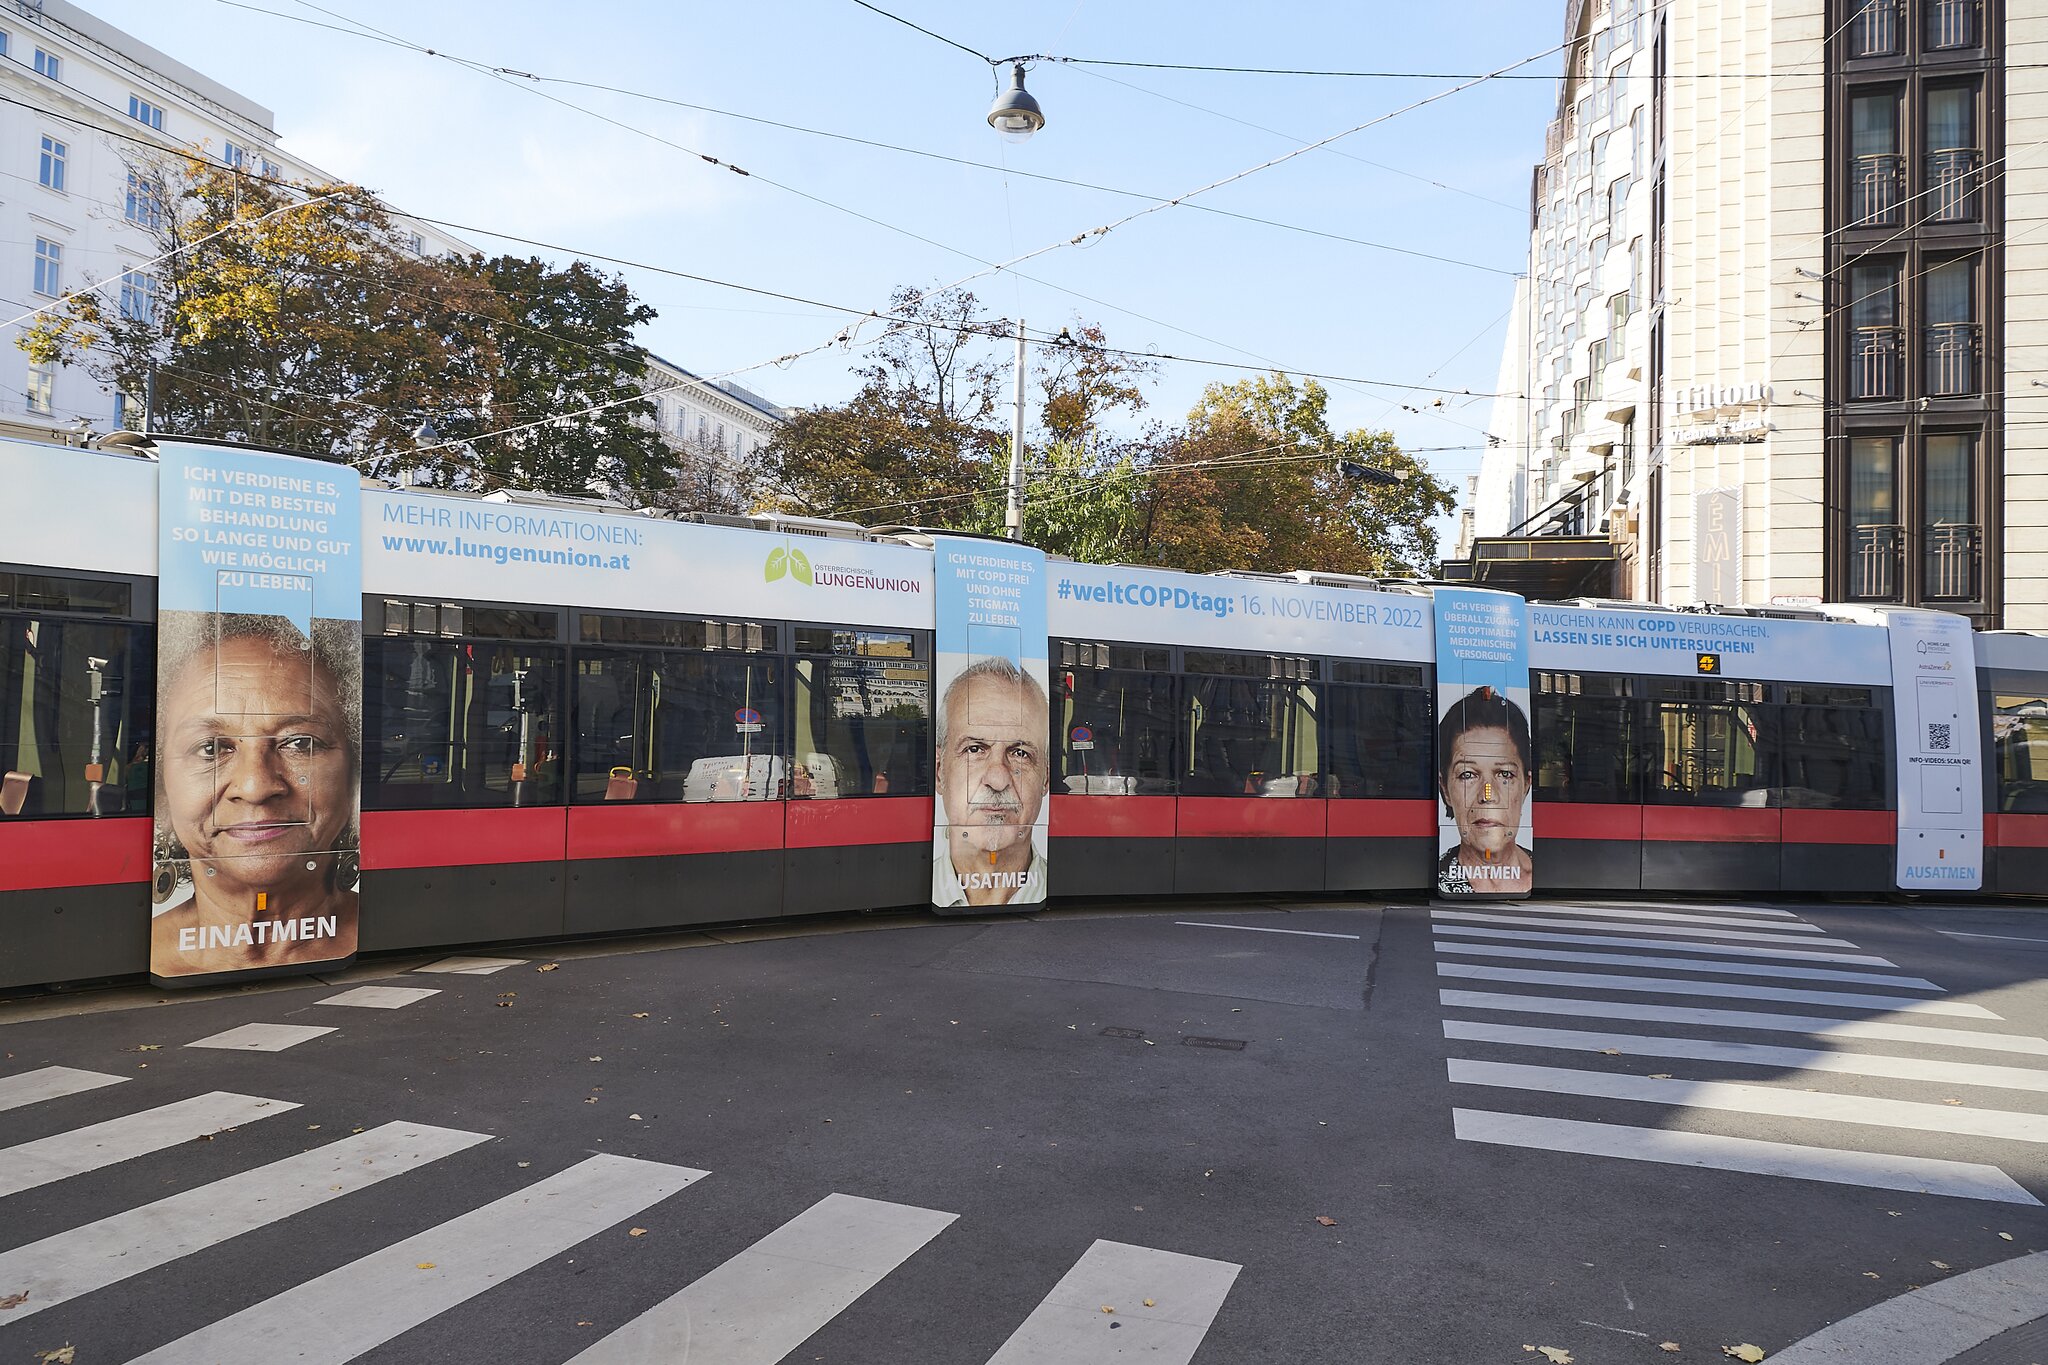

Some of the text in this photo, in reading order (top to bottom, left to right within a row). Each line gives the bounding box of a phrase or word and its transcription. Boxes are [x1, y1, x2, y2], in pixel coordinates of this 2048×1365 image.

[184, 466, 341, 499] ICH VERDIENE ES,
[189, 487, 337, 516] MIT DER BESTEN
[200, 508, 328, 534] BEHANDLUNG
[383, 502, 643, 547] MEHR INFORMATIONEN:
[172, 527, 351, 556] SO LANGE UND GUT
[202, 550, 327, 573] WIE MÖGLICH
[382, 535, 630, 571] www.lungenunion.at
[948, 553, 1036, 573] ICH VERDIENE ES,
[814, 564, 874, 576] ÖSTERREICHISCHE
[956, 568, 1030, 585] MIT COPD FREI
[218, 572, 312, 592] ZU LEBEN.
[815, 572, 920, 594] LUNGENUNION
[966, 584, 1021, 598] UND OHNE
[968, 598, 1020, 612] STIGMATA
[1058, 578, 1423, 628] #weltCOPDtag: 16. NOVEMBER 2022
[1452, 602, 1511, 615] ICH VERDIENE
[968, 612, 1020, 626] ZU LEBEN.
[1444, 611, 1520, 627] ÜBERALL ZUGANG
[1533, 612, 1770, 639] RAUCHEN KANN COPD VERURSACHEN.
[1448, 625, 1516, 638] ZUR OPTIMALEN
[1450, 637, 1516, 650] MEDIZINISCHEN
[1534, 630, 1755, 654] LASSEN SIE SICH UNTERSUCHEN!
[1453, 649, 1514, 662] VERSORGUNG.
[946, 872, 1038, 890] USATMEN
[1448, 865, 1520, 880] EINATMEN
[1905, 866, 1976, 880] AUSATMEN
[178, 915, 337, 951] EINATMEN
